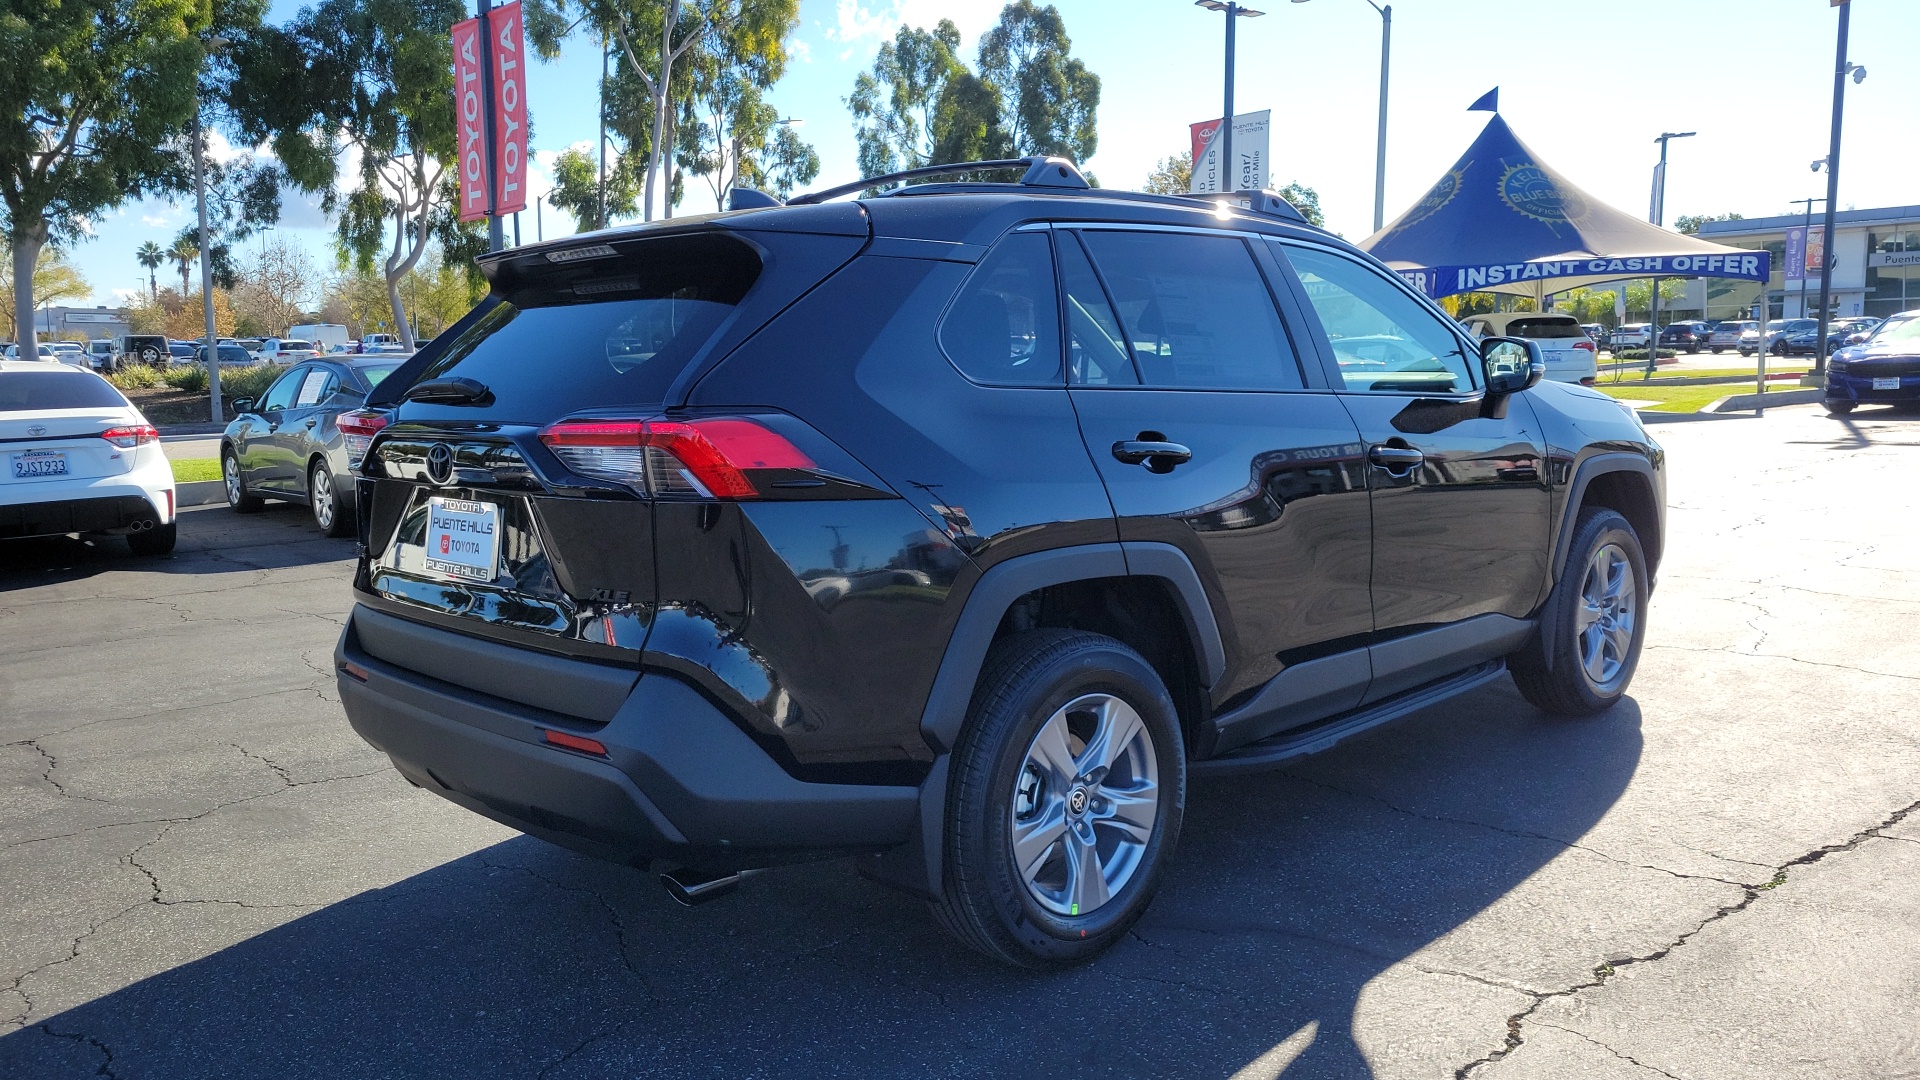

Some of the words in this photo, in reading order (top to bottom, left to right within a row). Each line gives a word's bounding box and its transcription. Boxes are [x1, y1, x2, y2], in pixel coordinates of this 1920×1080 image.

[500, 17, 519, 202] TOYOTA
[461, 32, 482, 209] TOYOTA
[1233, 122, 1254, 130] PUENTE
[1208, 150, 1216, 193] HICLES
[1510, 189, 1547, 203] BLUE
[1885, 255, 1920, 264] Puente
[1457, 260, 1580, 290] INSTANT
[1587, 257, 1662, 272] CASH
[1672, 255, 1759, 276] OFFER
[16, 460, 66, 474] 9JST933
[444, 500, 480, 513] TOYOTA
[432, 517, 467, 532] PUENTE
[468, 521, 494, 534] HILLS
[451, 540, 480, 554] TOYOTA
[426, 560, 461, 575] PUENTE
[461, 565, 488, 579] HILLS
[590, 588, 631, 603] XLE
